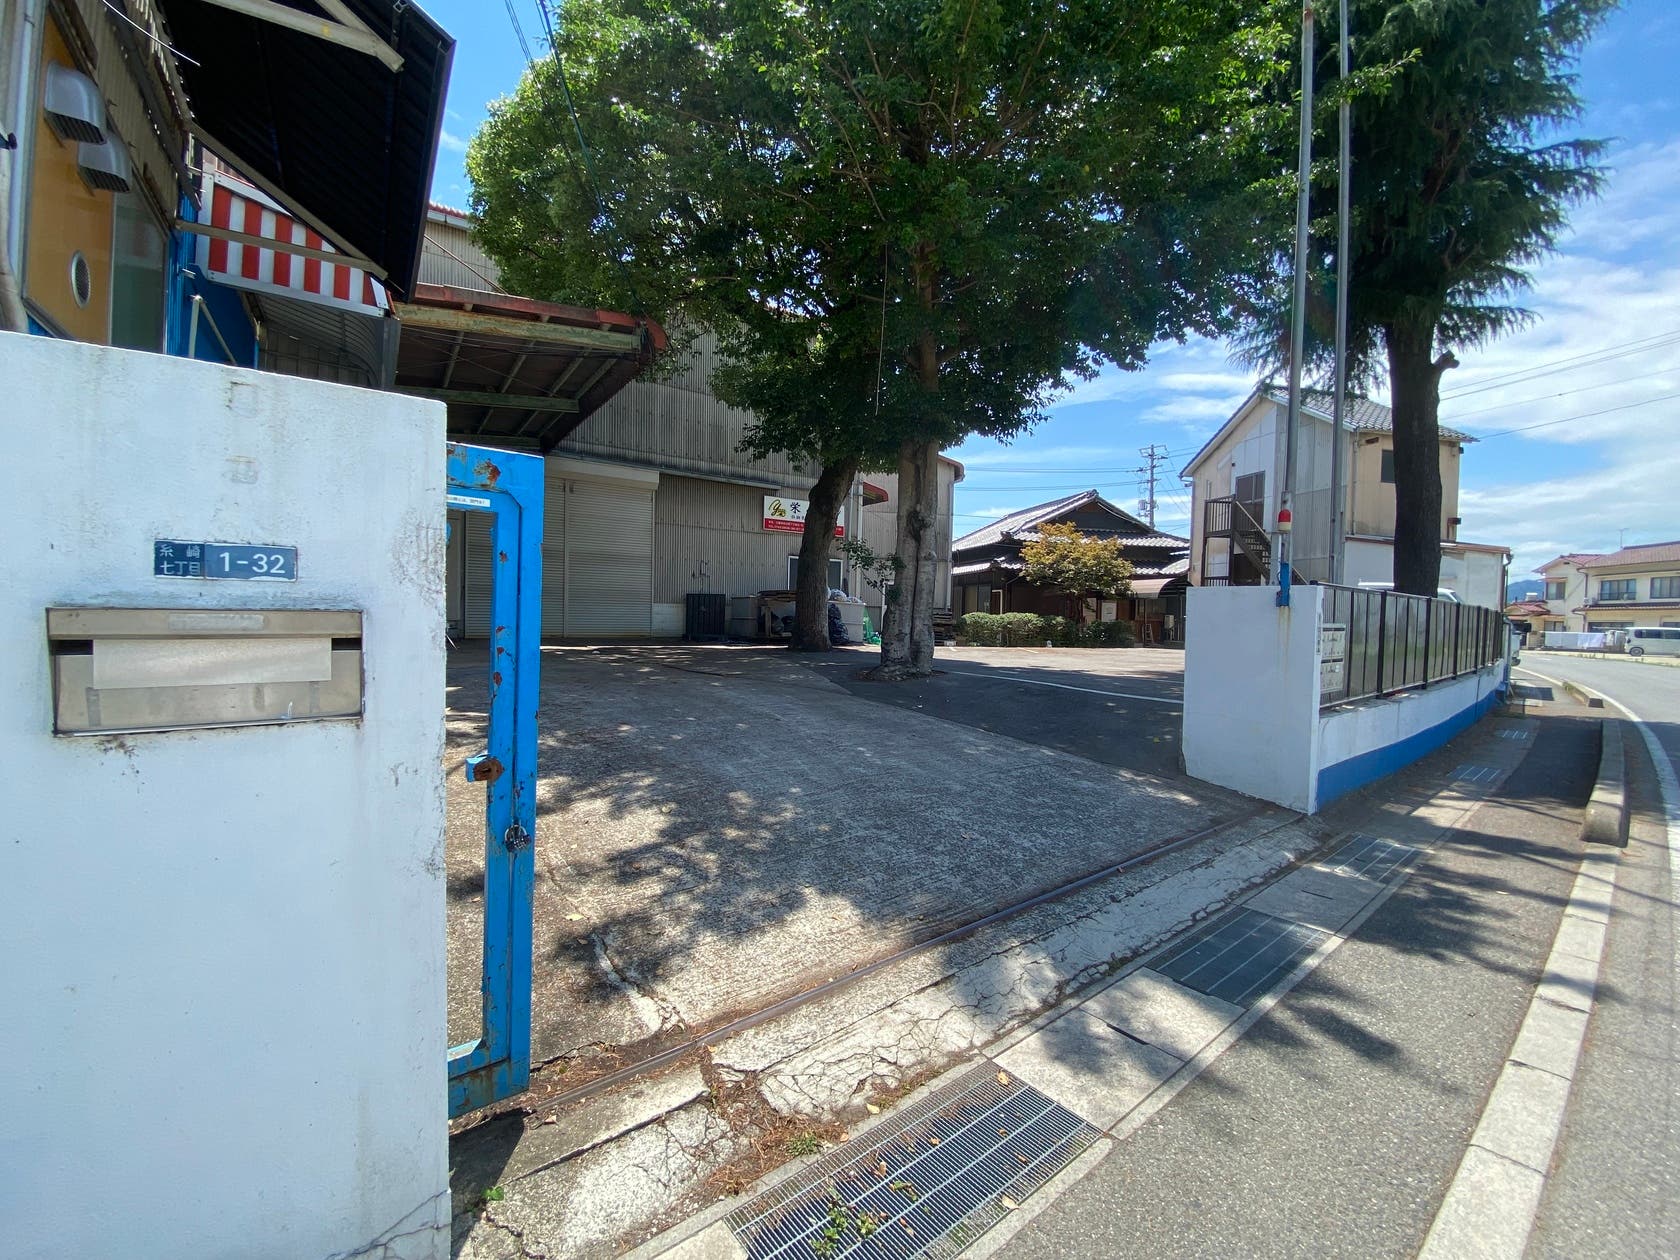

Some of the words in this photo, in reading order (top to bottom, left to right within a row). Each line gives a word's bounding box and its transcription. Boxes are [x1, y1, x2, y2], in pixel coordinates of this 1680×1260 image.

[159, 560, 201, 575] 七丁目
[219, 551, 286, 574] 1-32
